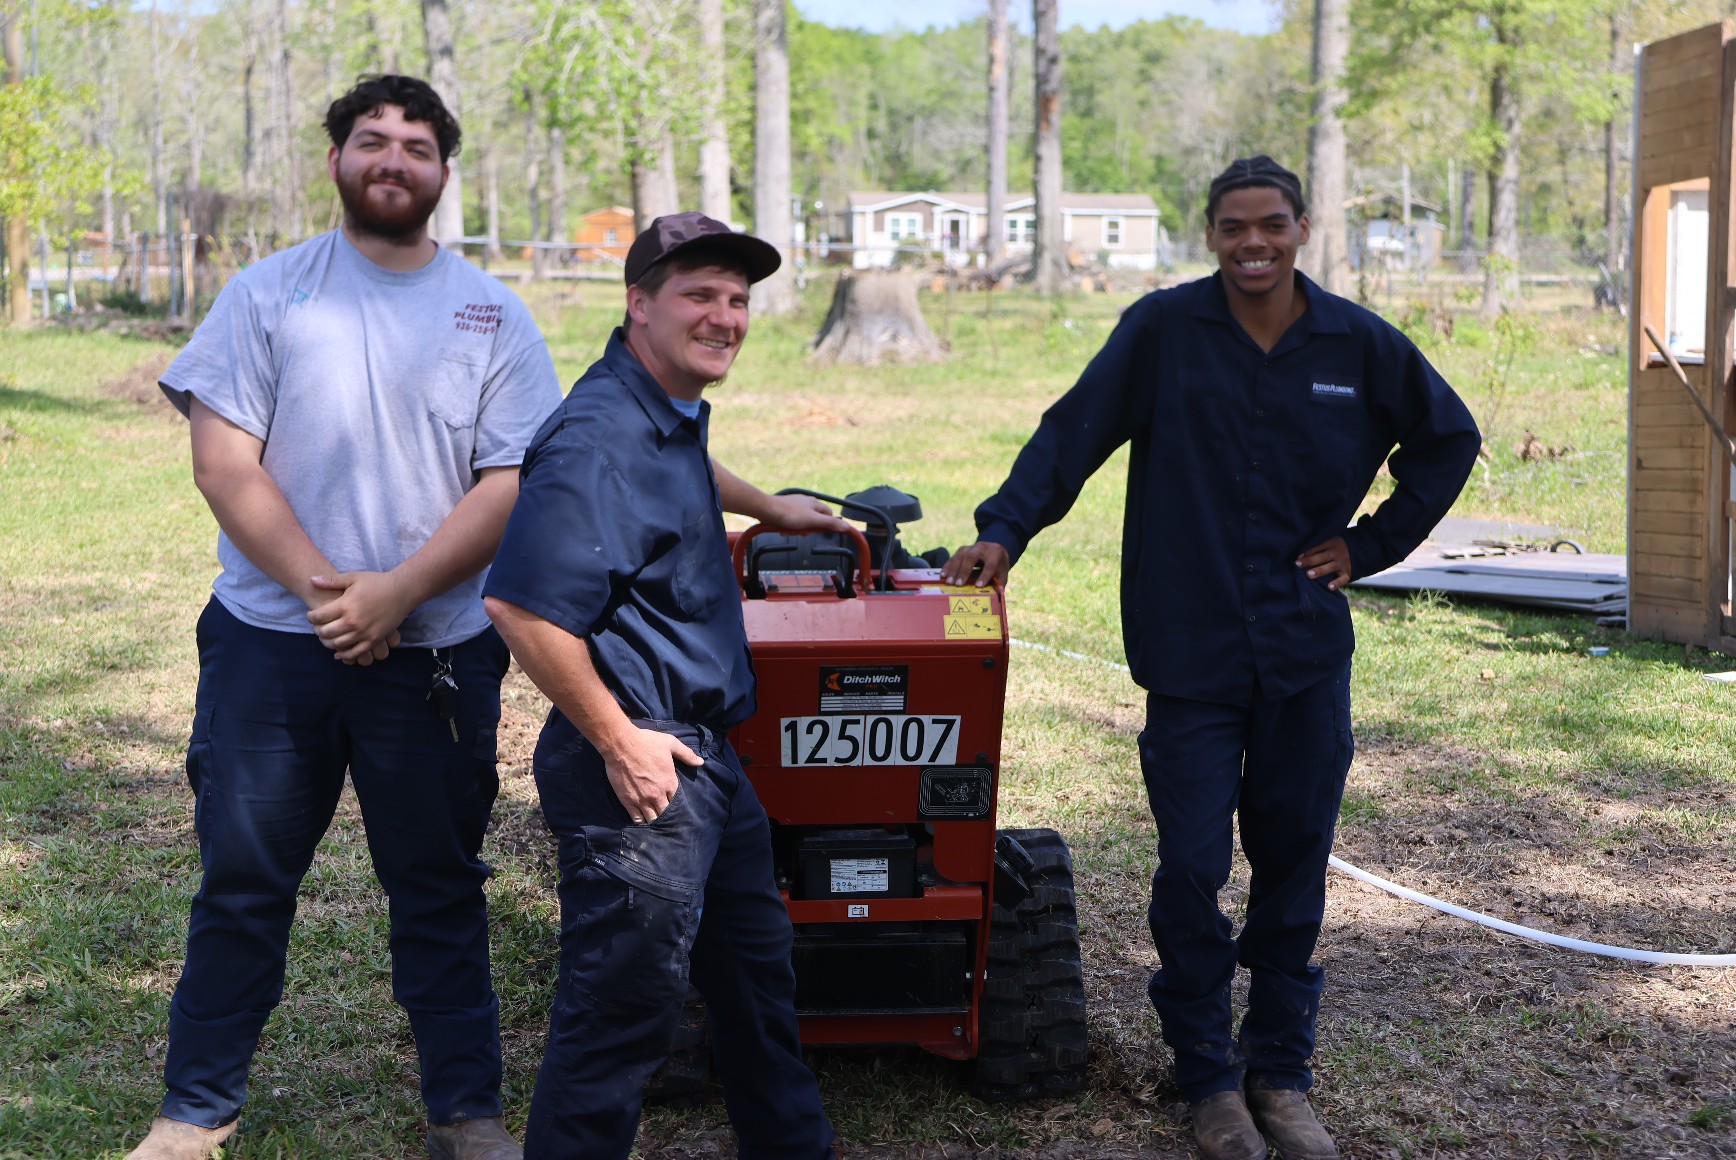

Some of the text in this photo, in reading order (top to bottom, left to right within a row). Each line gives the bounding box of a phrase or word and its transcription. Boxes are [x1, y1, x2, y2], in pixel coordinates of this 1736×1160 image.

[465, 304, 503, 313] FESTUS
[843, 674, 901, 684] Ditch Witch
[784, 716, 957, 765] 125007
